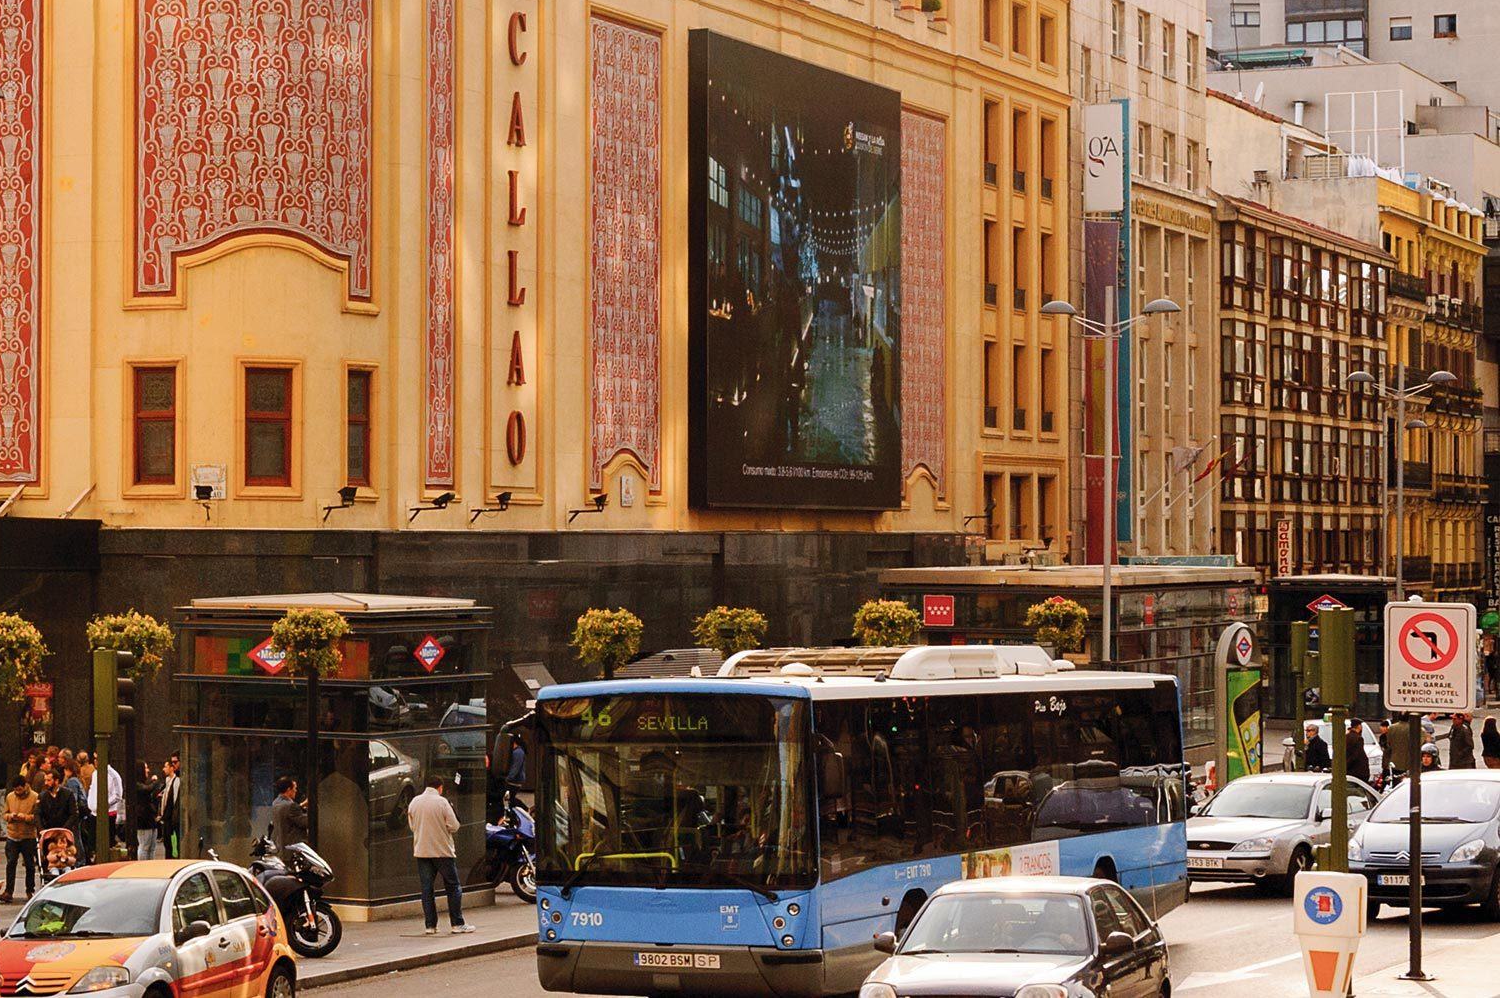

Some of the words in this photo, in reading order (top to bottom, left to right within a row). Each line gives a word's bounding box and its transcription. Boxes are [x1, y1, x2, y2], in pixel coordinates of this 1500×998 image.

[506, 11, 528, 467] CALLAO
[1488, 598, 1500, 607] BA
[260, 649, 287, 660] Metro
[420, 647, 439, 658] Metro
[1411, 673, 1445, 681] EXCEPTO
[637, 715, 709, 731] SEVILLA
[1204, 858, 1219, 868] BTK
[906, 865, 918, 880] EMT
[1383, 875, 1404, 886] 9117
[720, 905, 740, 914] EMT
[571, 912, 603, 926] 7910
[640, 954, 667, 966] 9802
[670, 954, 691, 966] BSM
